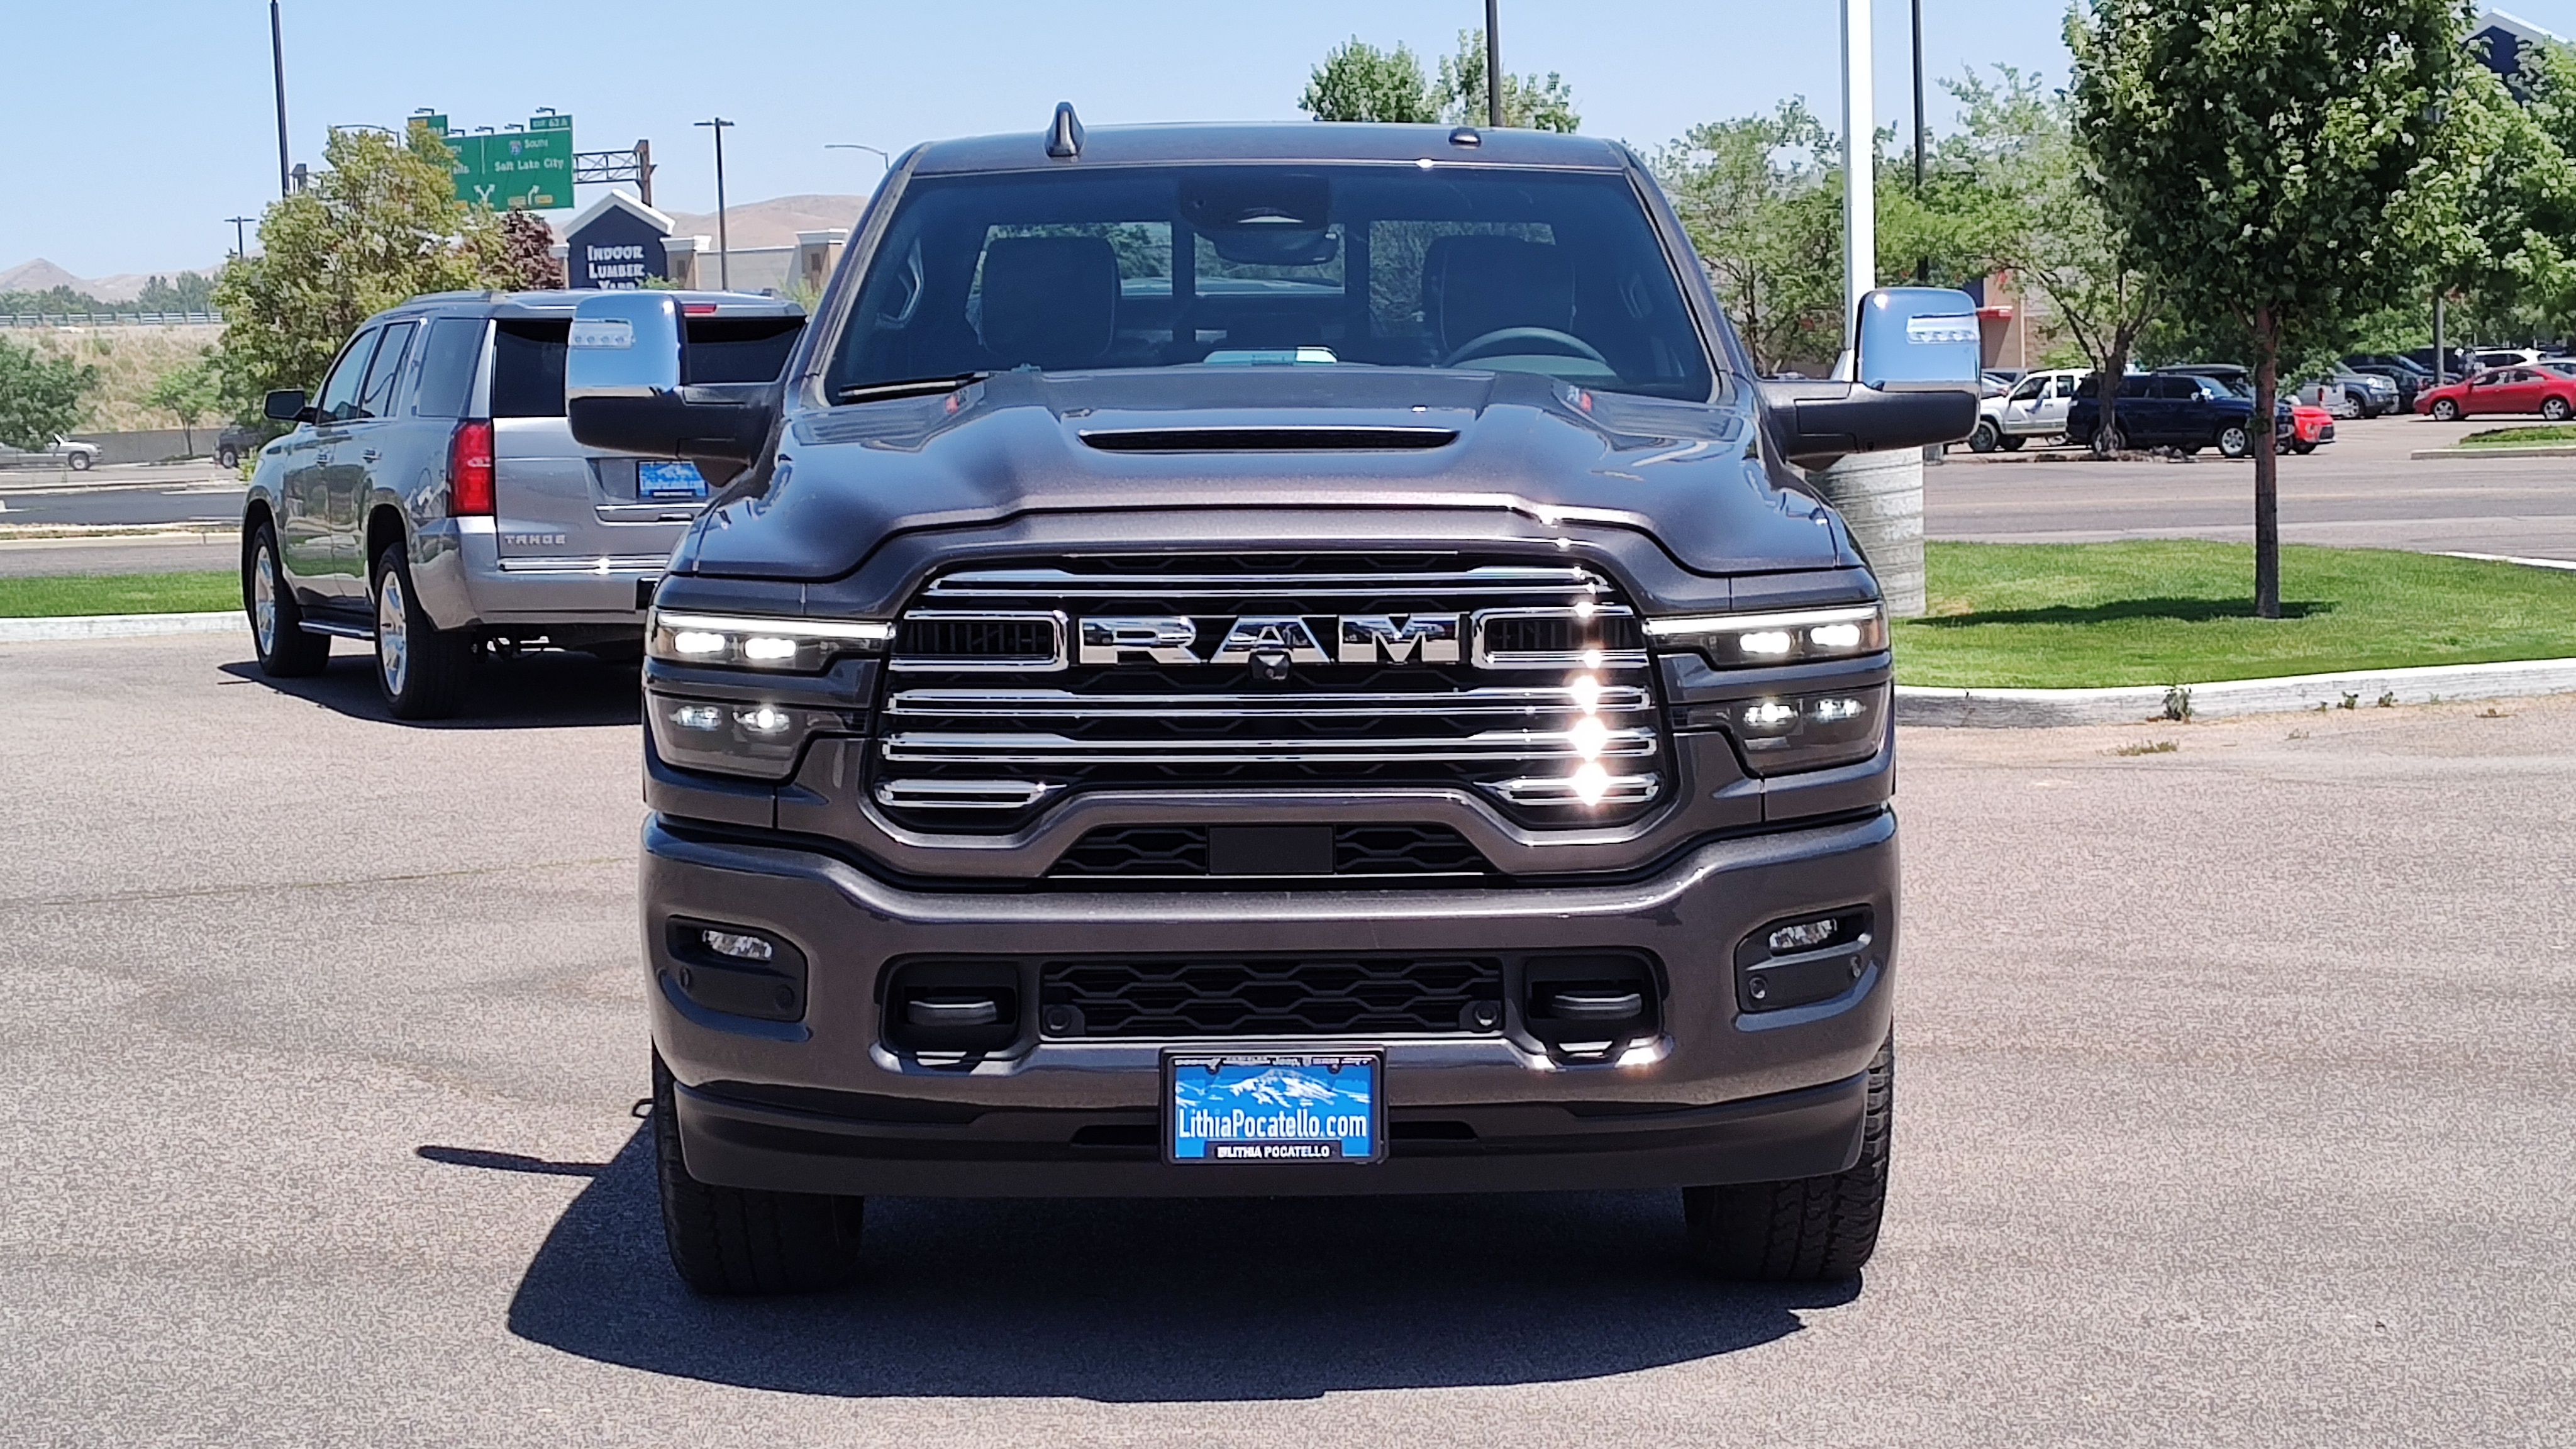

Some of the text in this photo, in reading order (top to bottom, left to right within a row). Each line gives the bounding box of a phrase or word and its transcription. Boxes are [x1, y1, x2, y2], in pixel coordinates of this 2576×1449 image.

[494, 158, 564, 172] Salt Lake City
[587, 245, 644, 261] INDOOR
[589, 263, 645, 279] LUMBER
[504, 535, 565, 545] TAHOE
[1079, 614, 1461, 665] RAM
[1179, 1108, 1367, 1138] LithiaPocatello.com
[1228, 1145, 1330, 1158] LITHIA POCATELLO
